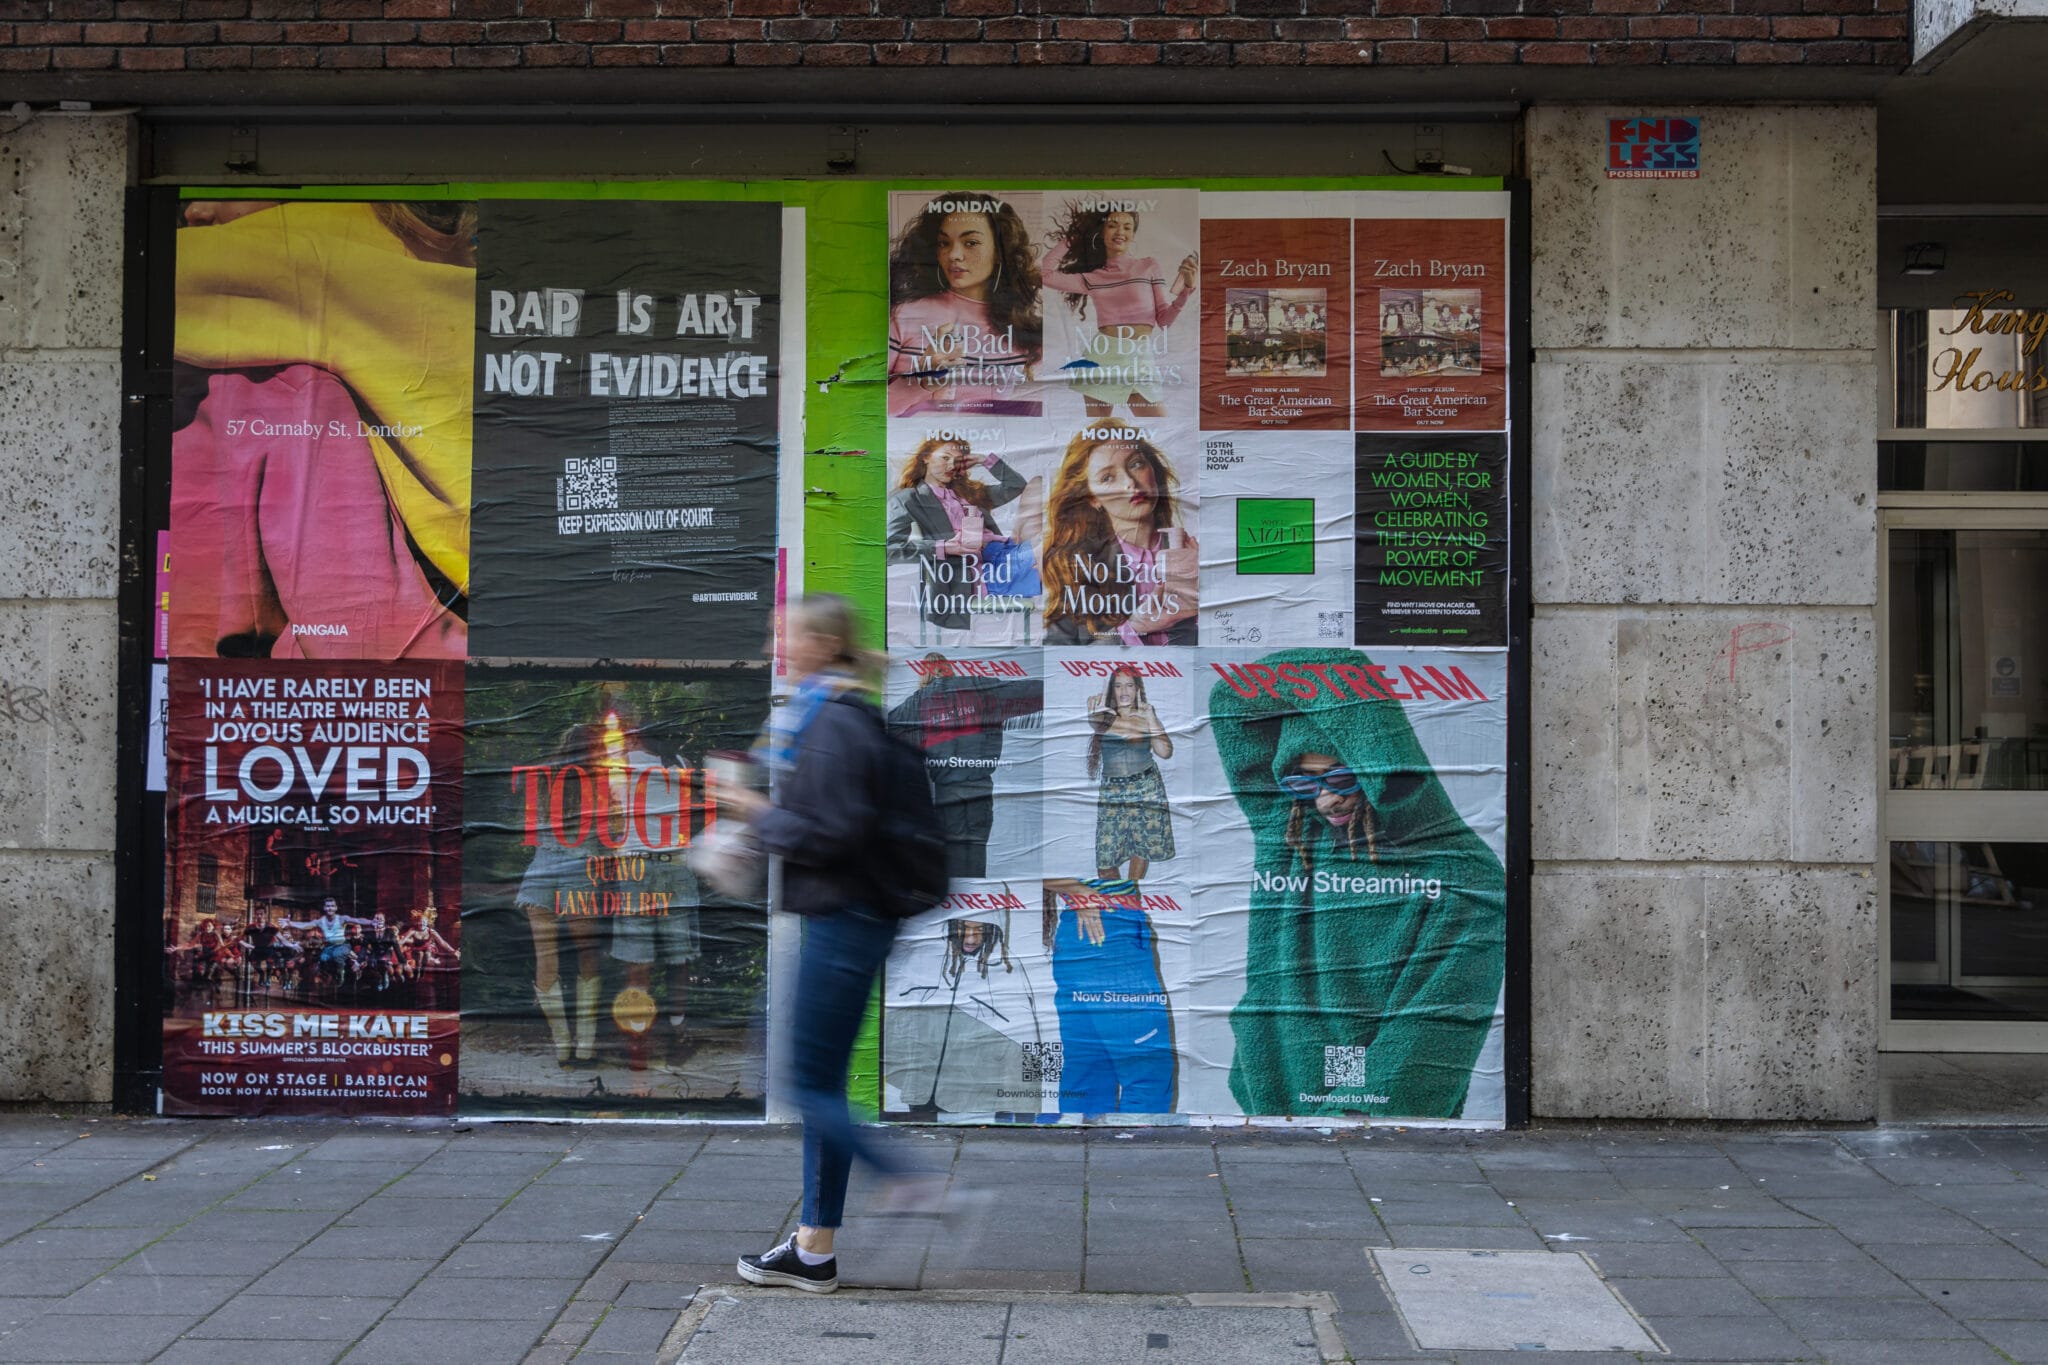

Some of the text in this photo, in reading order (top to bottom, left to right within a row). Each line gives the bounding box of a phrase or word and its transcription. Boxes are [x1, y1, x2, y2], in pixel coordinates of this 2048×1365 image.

[1608, 170, 1697, 178] POSSIBILITIES
[928, 200, 1004, 213] MONDAY
[1079, 199, 1159, 213] MONDAY
[1220, 260, 1331, 281] Zach Bryan
[1373, 260, 1485, 281] Zach Bryan
[490, 290, 761, 338] RAP IS ART
[921, 325, 1013, 354] No Bad
[1074, 325, 1168, 354] No Bad
[484, 352, 768, 398] NOT EVIDENCE
[908, 355, 1026, 392] Mondays
[1219, 395, 1332, 405] The Great American
[1374, 395, 1487, 405] The Great American
[1248, 406, 1303, 416] Bar Scene
[1403, 406, 1458, 416] Bar Scene
[226, 419, 424, 439] 57 Carnaby St, London
[926, 428, 1003, 441] MONDAY
[1082, 427, 1159, 440] MONDAY
[1384, 452, 1479, 468] A GUIDE BY
[1372, 472, 1491, 490] WOMEN, FOR
[1390, 492, 1472, 510] WOMEN,
[558, 515, 583, 535] KEEP
[644, 510, 664, 530] OUT
[666, 509, 679, 529] OF
[680, 507, 713, 527] COURT
[1374, 511, 1488, 527] CELEBRATING
[1376, 531, 1486, 547] THE JOY AND
[1386, 550, 1478, 567] POWER OF
[920, 554, 1012, 583] No Bad
[1074, 554, 1166, 583] No Bad
[1379, 571, 1484, 586] MOVEMENT
[692, 591, 758, 603] @ARTNOTEVIDENCE
[909, 585, 1024, 621] Mondays
[1063, 585, 1180, 621] Mondays
[292, 624, 349, 636] PANGAIA
[906, 660, 1028, 676] UPSTREAM
[1060, 661, 1183, 677] UPSTREAM
[218, 678, 276, 698] HAVE
[283, 678, 368, 698] RARELY
[374, 678, 431, 698] BEEN
[1210, 663, 1488, 700] UPSTREAM
[205, 702, 430, 719] IN A THEATRE WHERE A
[205, 722, 430, 743] JOYOUS AUDIENCE
[949, 756, 1012, 770] Streaming
[205, 745, 431, 802] LOVED
[511, 764, 717, 848] TOUGH
[205, 806, 221, 824] A
[228, 806, 323, 824] MUSICAL
[329, 806, 360, 824] SO
[586, 855, 645, 887] QUAVO
[1253, 871, 1441, 899] Now Streaming
[554, 891, 672, 917] LANA DEL REY
[941, 893, 1027, 910] STREAM
[1059, 892, 1182, 911] UPSTREAM
[1073, 990, 1167, 1005] Now Streaming
[203, 1013, 287, 1038] KISS
[349, 1015, 429, 1039] KATE
[201, 1072, 428, 1086] NOW ON STAGE BARBICAN
[201, 1087, 428, 1098] BOOK NOW AT KISSMEKATEMUSICAL.COM
[997, 1088, 1088, 1098] Download to Wear
[1300, 1093, 1390, 1103] Download to Wear
